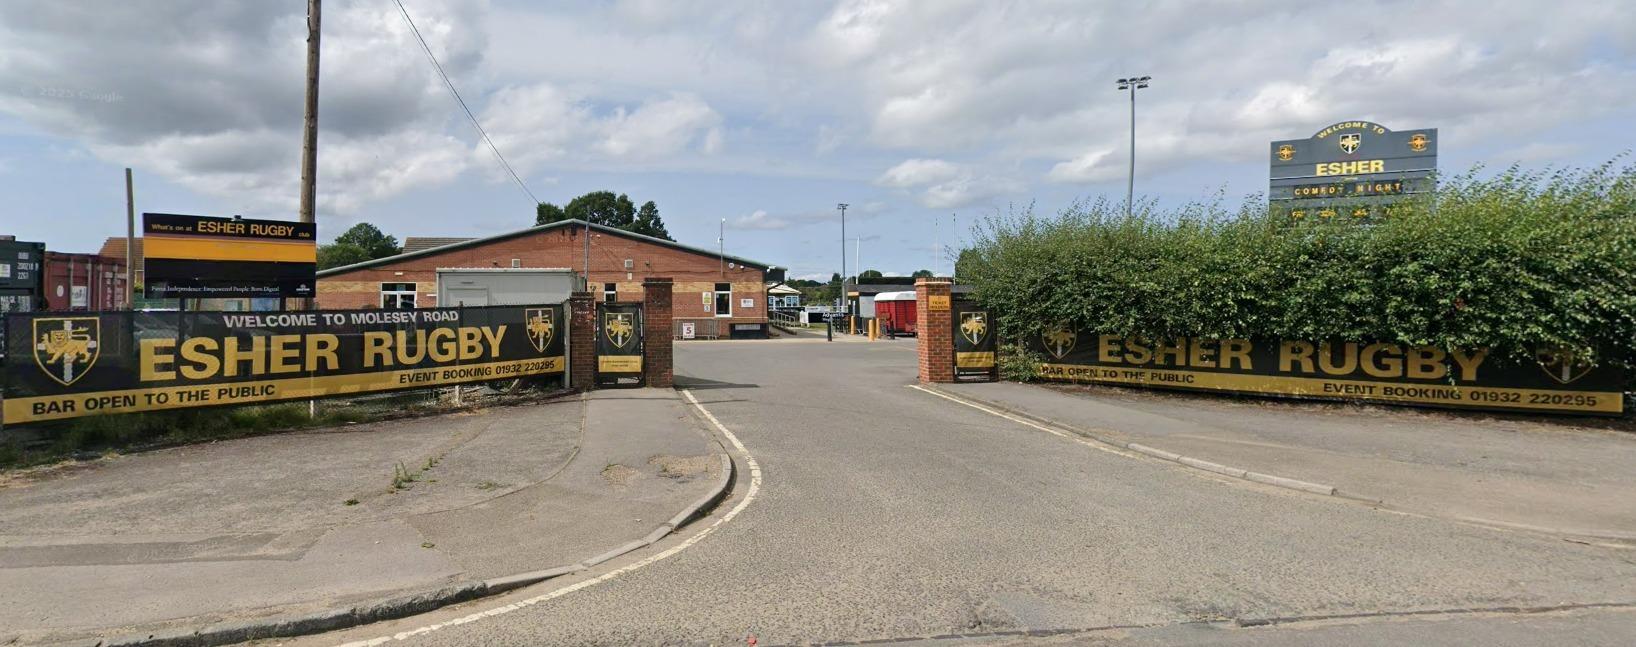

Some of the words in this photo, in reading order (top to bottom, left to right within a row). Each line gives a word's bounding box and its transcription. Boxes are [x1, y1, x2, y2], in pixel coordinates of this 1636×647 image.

[1317, 121, 1368, 139] WELCOME
[1372, 125, 1385, 135] TO
[1316, 159, 1385, 176] ESHER
[1356, 182, 1401, 193] NIGHT
[151, 223, 174, 231] What's
[197, 221, 245, 234] ESHER
[251, 224, 295, 237] RUGBY
[223, 314, 317, 328] WELCOME
[322, 313, 346, 326] TO
[351, 311, 418, 325] MOLESEY
[423, 310, 459, 323] ROAD
[140, 333, 340, 382] ESHER
[363, 325, 508, 368] RUGBY
[1098, 333, 1253, 369] ESHER
[1279, 339, 1488, 381] RUGBY
[400, 371, 439, 384] EVENT
[443, 366, 492, 381] BOOKING
[495, 363, 522, 375] 01932
[524, 360, 555, 372] 220295
[1041, 365, 1063, 375] BAR
[1068, 367, 1098, 378] OPEN
[1102, 369, 1118, 379] TO
[1122, 370, 1145, 380] THE
[1151, 372, 1195, 384] PUBLIC
[32, 399, 76, 416] BAR
[84, 395, 136, 411] OPEN
[144, 392, 169, 406] TO
[176, 389, 210, 403] THE
[217, 384, 276, 400] PUBLIC
[1323, 382, 1377, 395] EVENT
[1383, 386, 1462, 400] BOOKING
[1470, 390, 1521, 403] 01932
[1528, 393, 1598, 407] 220295
